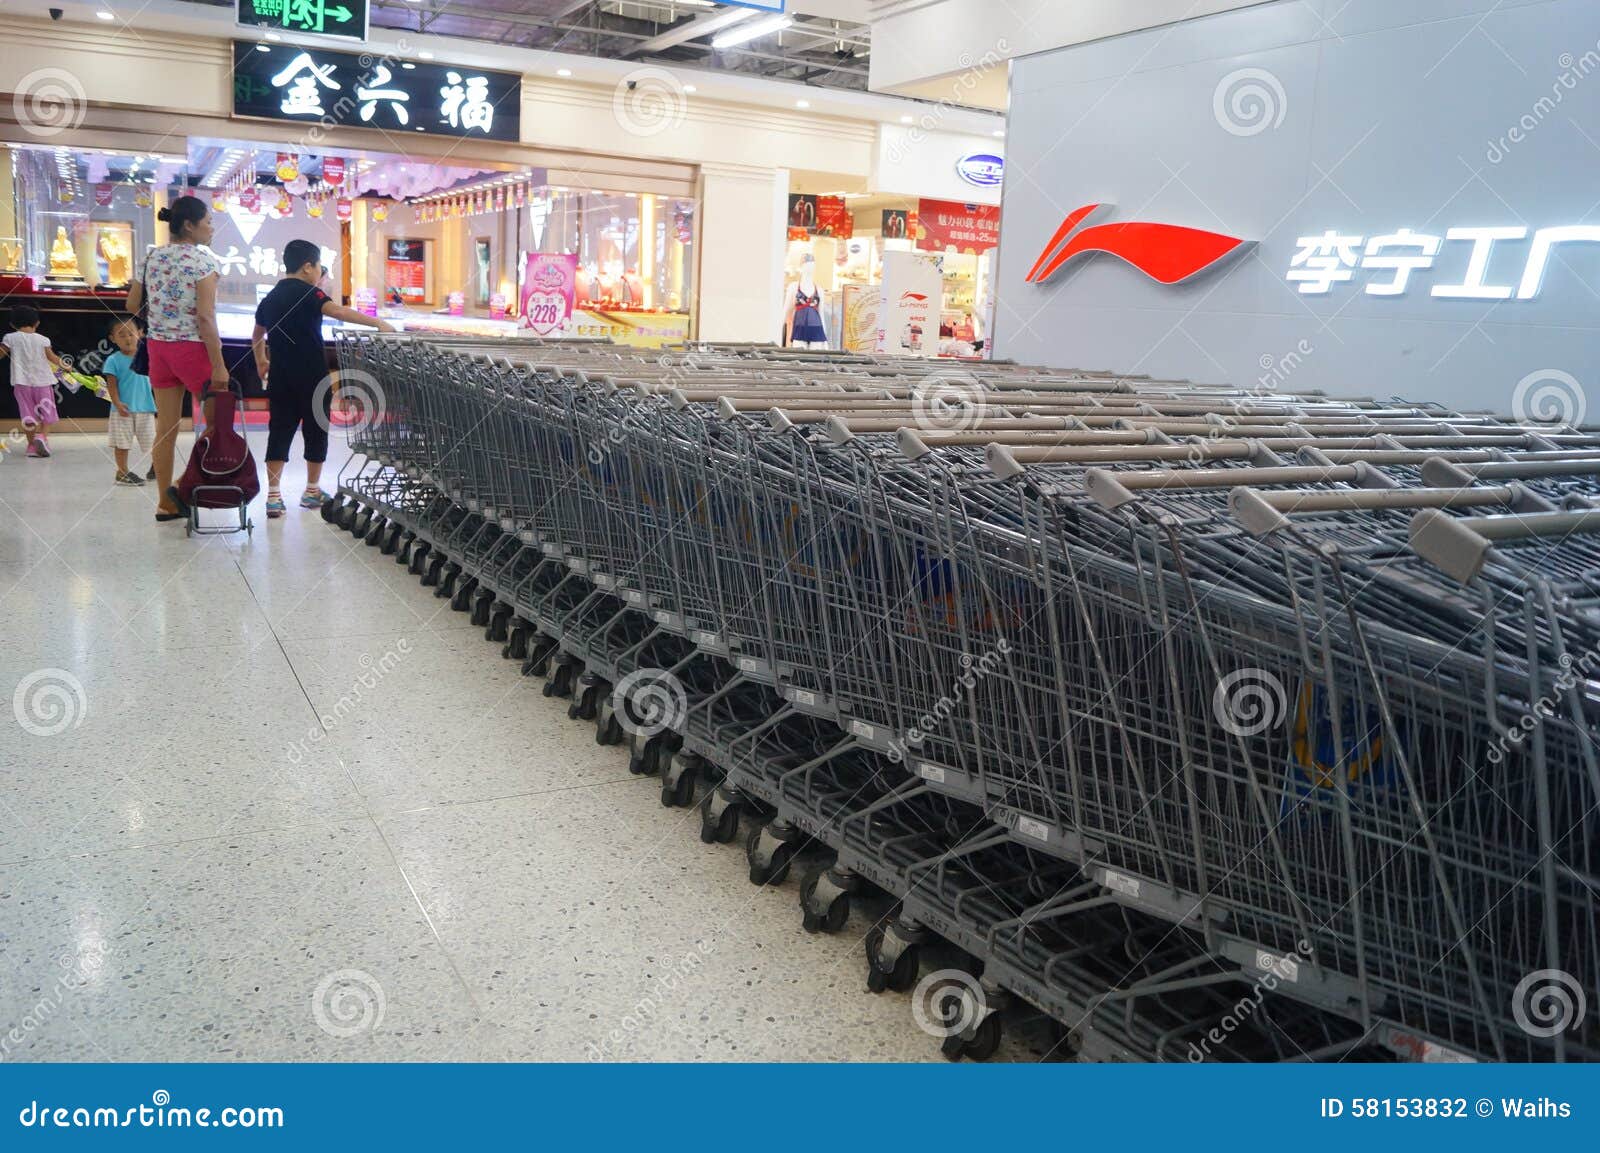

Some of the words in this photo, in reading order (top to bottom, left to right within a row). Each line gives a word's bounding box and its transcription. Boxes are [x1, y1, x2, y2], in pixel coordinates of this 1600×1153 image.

[255, 8, 280, 17] EXIT
[271, 52, 494, 134] 金六福
[1285, 225, 1600, 300] 李宁工厂
[533, 304, 558, 324] 228
